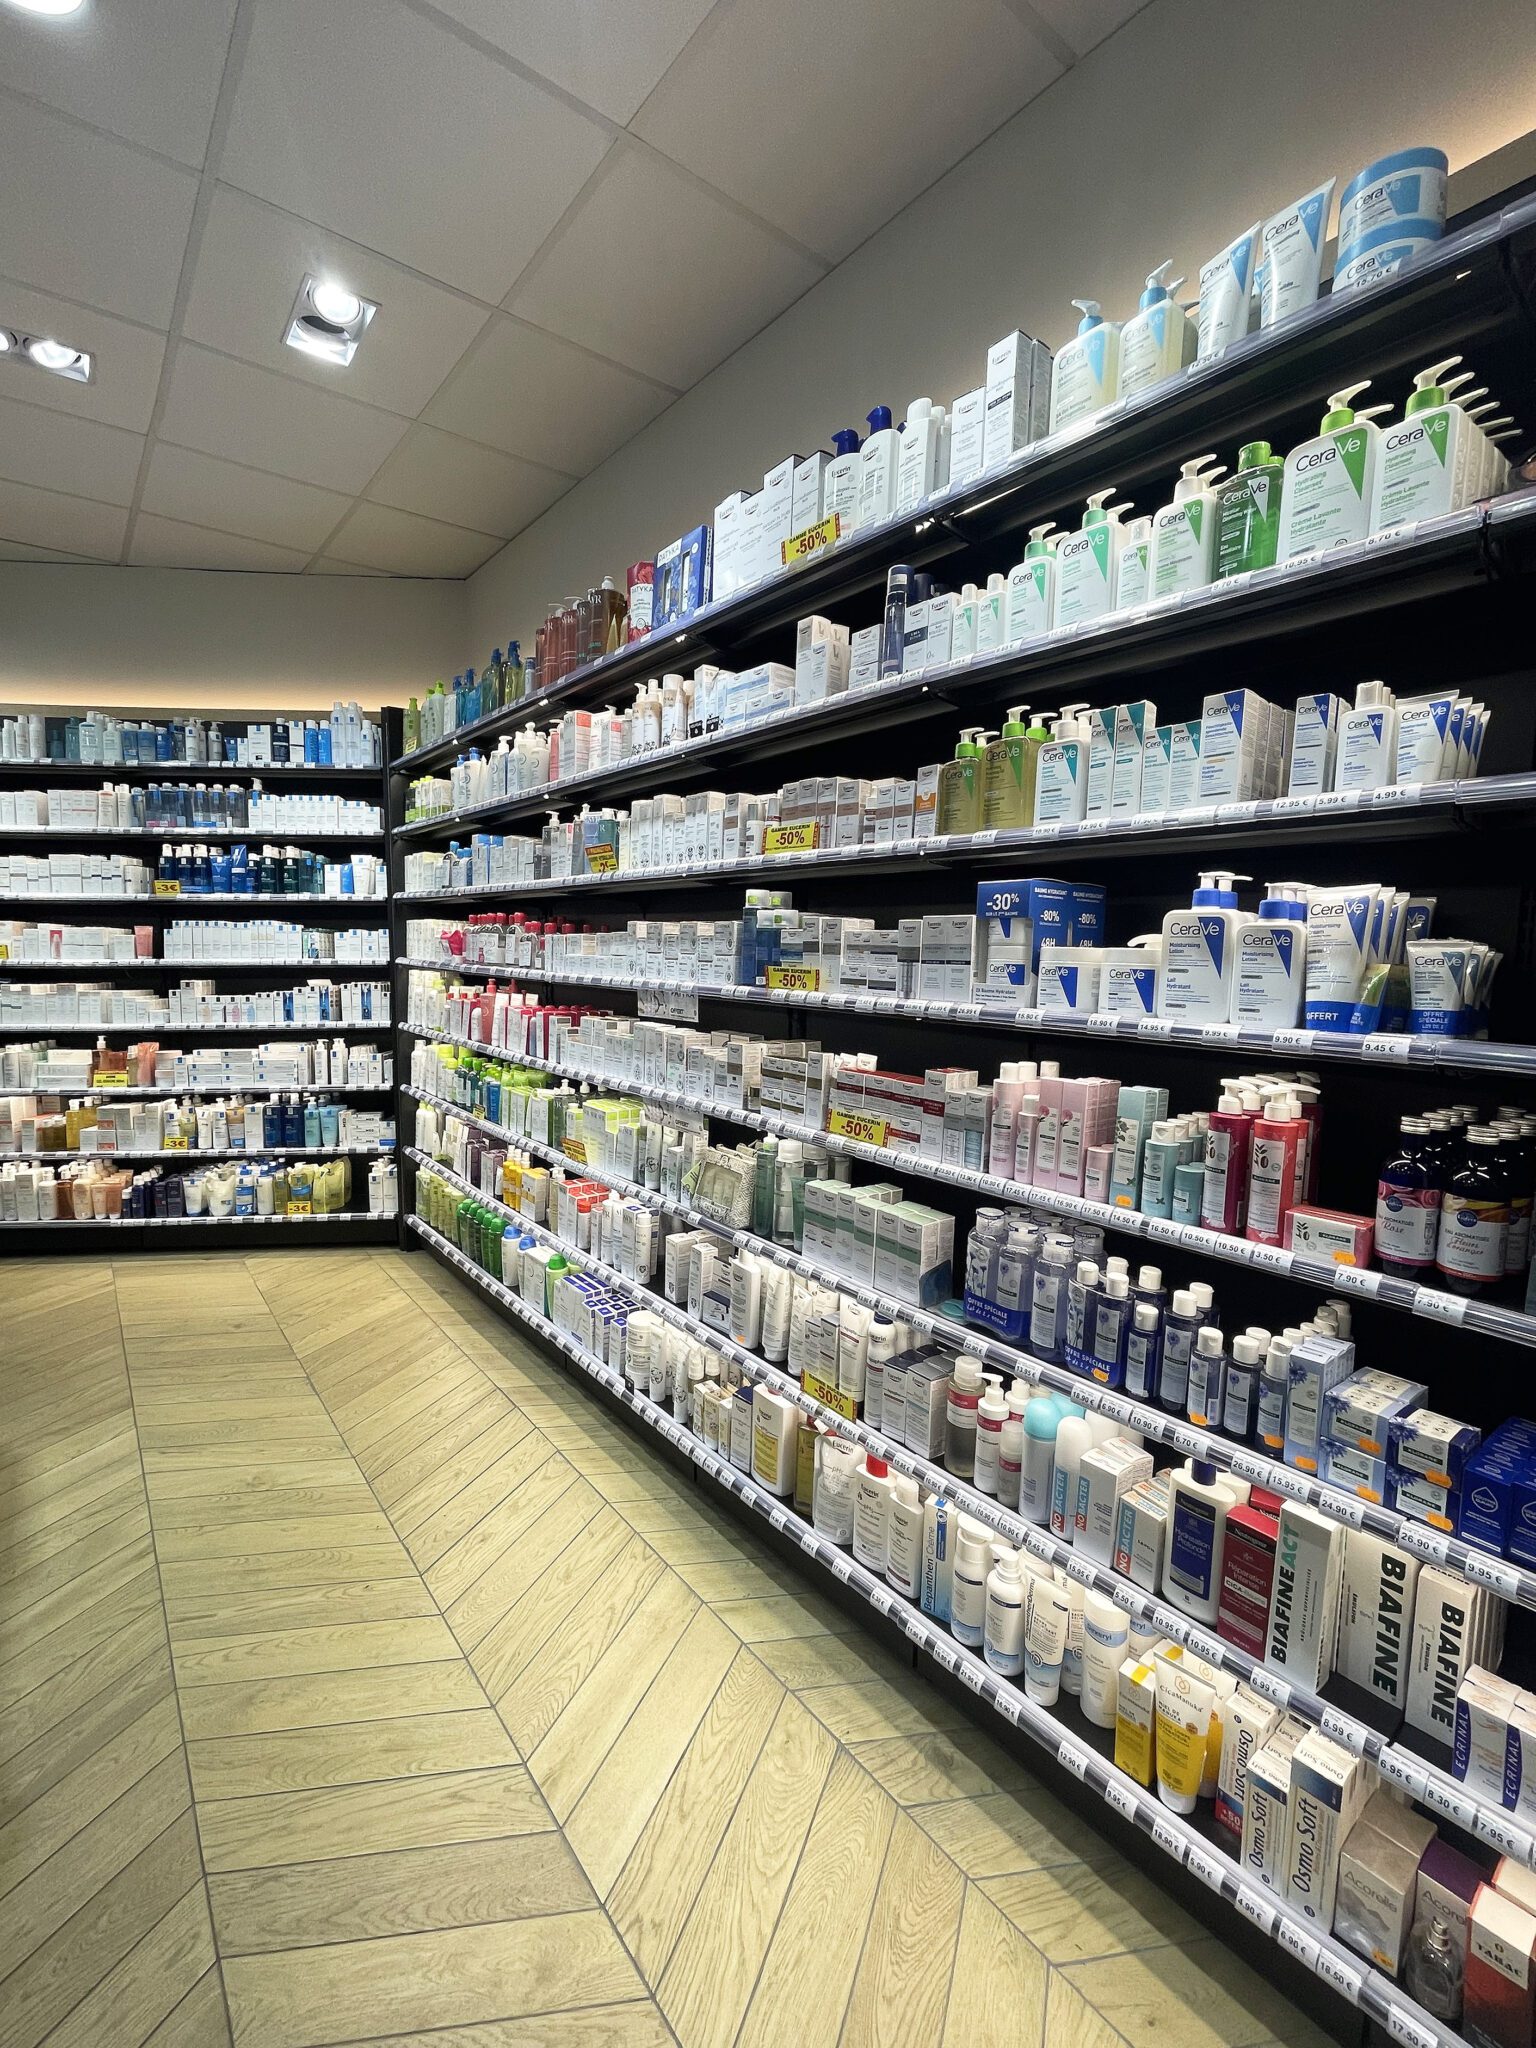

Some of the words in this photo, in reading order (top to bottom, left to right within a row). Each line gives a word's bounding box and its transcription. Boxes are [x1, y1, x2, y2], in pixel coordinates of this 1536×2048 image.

[1355, 180, 1401, 210] CeraVe
[1265, 201, 1319, 242] CeraVe
[1201, 243, 1247, 284] CeraVe
[1347, 249, 1393, 280] CeraVe
[1386, 419, 1447, 450] CeraVe
[1296, 438, 1360, 472] CeraVe
[831, 466, 851, 478] Eucerin
[1223, 481, 1267, 505] CeraVe
[1160, 505, 1201, 528] CeraVe
[1314, 507, 1342, 520] Lavante
[789, 531, 807, 544] GAMME
[808, 518, 831, 535] EUCERIN
[795, 530, 827, 555] -50%
[1063, 532, 1105, 557] CeraVe
[1012, 568, 1045, 586] CeraVe
[1206, 703, 1240, 717] CeraVe
[1298, 703, 1327, 714] CeraVe
[1402, 705, 1447, 721] CeraVe
[1348, 718, 1382, 730] CeraVe
[986, 747, 1020, 762] CeraVe
[1043, 749, 1077, 762] CeraVe
[945, 768, 973, 780] CeraVe
[1375, 790, 1397, 801] 4.99
[776, 831, 805, 845] -50%
[157, 883, 177, 893] -3€
[987, 893, 1019, 911] -30%
[1310, 901, 1365, 916] CeraVe
[1041, 910, 1060, 922] -80%
[1079, 913, 1096, 925] -80%
[1171, 922, 1219, 935] CeraVe
[1243, 934, 1290, 946] CeraVe
[990, 964, 1017, 974] CeraVe
[1415, 956, 1461, 967] CeraVe
[1041, 966, 1068, 976] CeraVe
[1110, 968, 1144, 979] CeraVe
[779, 974, 807, 988] -50%
[1306, 1012, 1339, 1021] OFFERT
[1418, 1016, 1448, 1024] SPÉCIALE
[1365, 1043, 1386, 1052] 9.45
[837, 1112, 856, 1121] GAMME
[857, 1116, 880, 1126] EUCERIN
[841, 1120, 874, 1141] -50%
[165, 1139, 186, 1148] -3€
[289, 1204, 309, 1213] -3€
[1113, 1214, 1130, 1224] 14.50
[1151, 1223, 1170, 1235] 16.50
[1382, 1221, 1404, 1234] Rose
[1184, 1232, 1204, 1243] 10.50
[1218, 1241, 1239, 1253] 10.50
[1256, 1250, 1274, 1262] 3.50
[984, 1303, 1008, 1319] SPÉCIALE
[1082, 1354, 1111, 1372] SPÉCIALE
[814, 1384, 844, 1412] -50%
[827, 1384, 849, 1401] EUCERIN
[1133, 1416, 1152, 1430] 10.90
[832, 1440, 853, 1453] Eucerin
[1175, 1437, 1191, 1448] 6.70
[1409, 1449, 1441, 1464] KLORANE
[1233, 1462, 1255, 1475] 26.90
[861, 1484, 879, 1498] Eucerin
[1272, 1476, 1294, 1491] 15.95
[1053, 1473, 1064, 1530] NOBACTER
[1077, 1480, 1088, 1529] NOBACTER
[1322, 1500, 1347, 1515] 24.90
[1406, 1494, 1440, 1510] KLORANE
[1001, 1523, 1014, 1536] 10.90
[1119, 1509, 1135, 1571] NOBACTER
[1235, 1528, 1267, 1548] Neutrogena
[1402, 1532, 1429, 1550] 26.90
[1069, 1563, 1085, 1578] 15.95
[1229, 1561, 1266, 1586] Réparation
[1468, 1563, 1491, 1580] 9.95
[925, 1558, 934, 1611] Bepanthen
[1115, 1592, 1129, 1604] 5.50
[1155, 1616, 1174, 1632] 10.95
[1373, 1553, 1406, 1697] BIAFINE
[1190, 1639, 1210, 1655] 10.95
[1431, 1601, 1465, 1729] BIAFINE
[1252, 1677, 1270, 1692] 6.99
[1158, 1706, 1181, 1723] MANUKA
[1323, 1718, 1344, 1736] 8.99
[1456, 1712, 1468, 1770] ECRINAL
[1380, 1760, 1403, 1778] 6.95
[1506, 1739, 1520, 1800] ECRINAL
[1252, 1792, 1268, 1824] Soft
[1427, 1790, 1449, 1810] 8.30
[1297, 1797, 1318, 1840] Soft
[1480, 1822, 1504, 1843] 7.95
[1249, 1827, 1266, 1868] Osmo
[1190, 1857, 1206, 1874] 5.90
[1292, 1848, 1313, 1893] Osmo
[1343, 1869, 1398, 1914] Acorelle
[1238, 1898, 1255, 1916] 4.90
[1281, 1931, 1298, 1949] 6.90
[1476, 1942, 1523, 1978] TABAC
[1320, 1962, 1345, 1985] 18.50
[1392, 2021, 1419, 2045] 17.50
